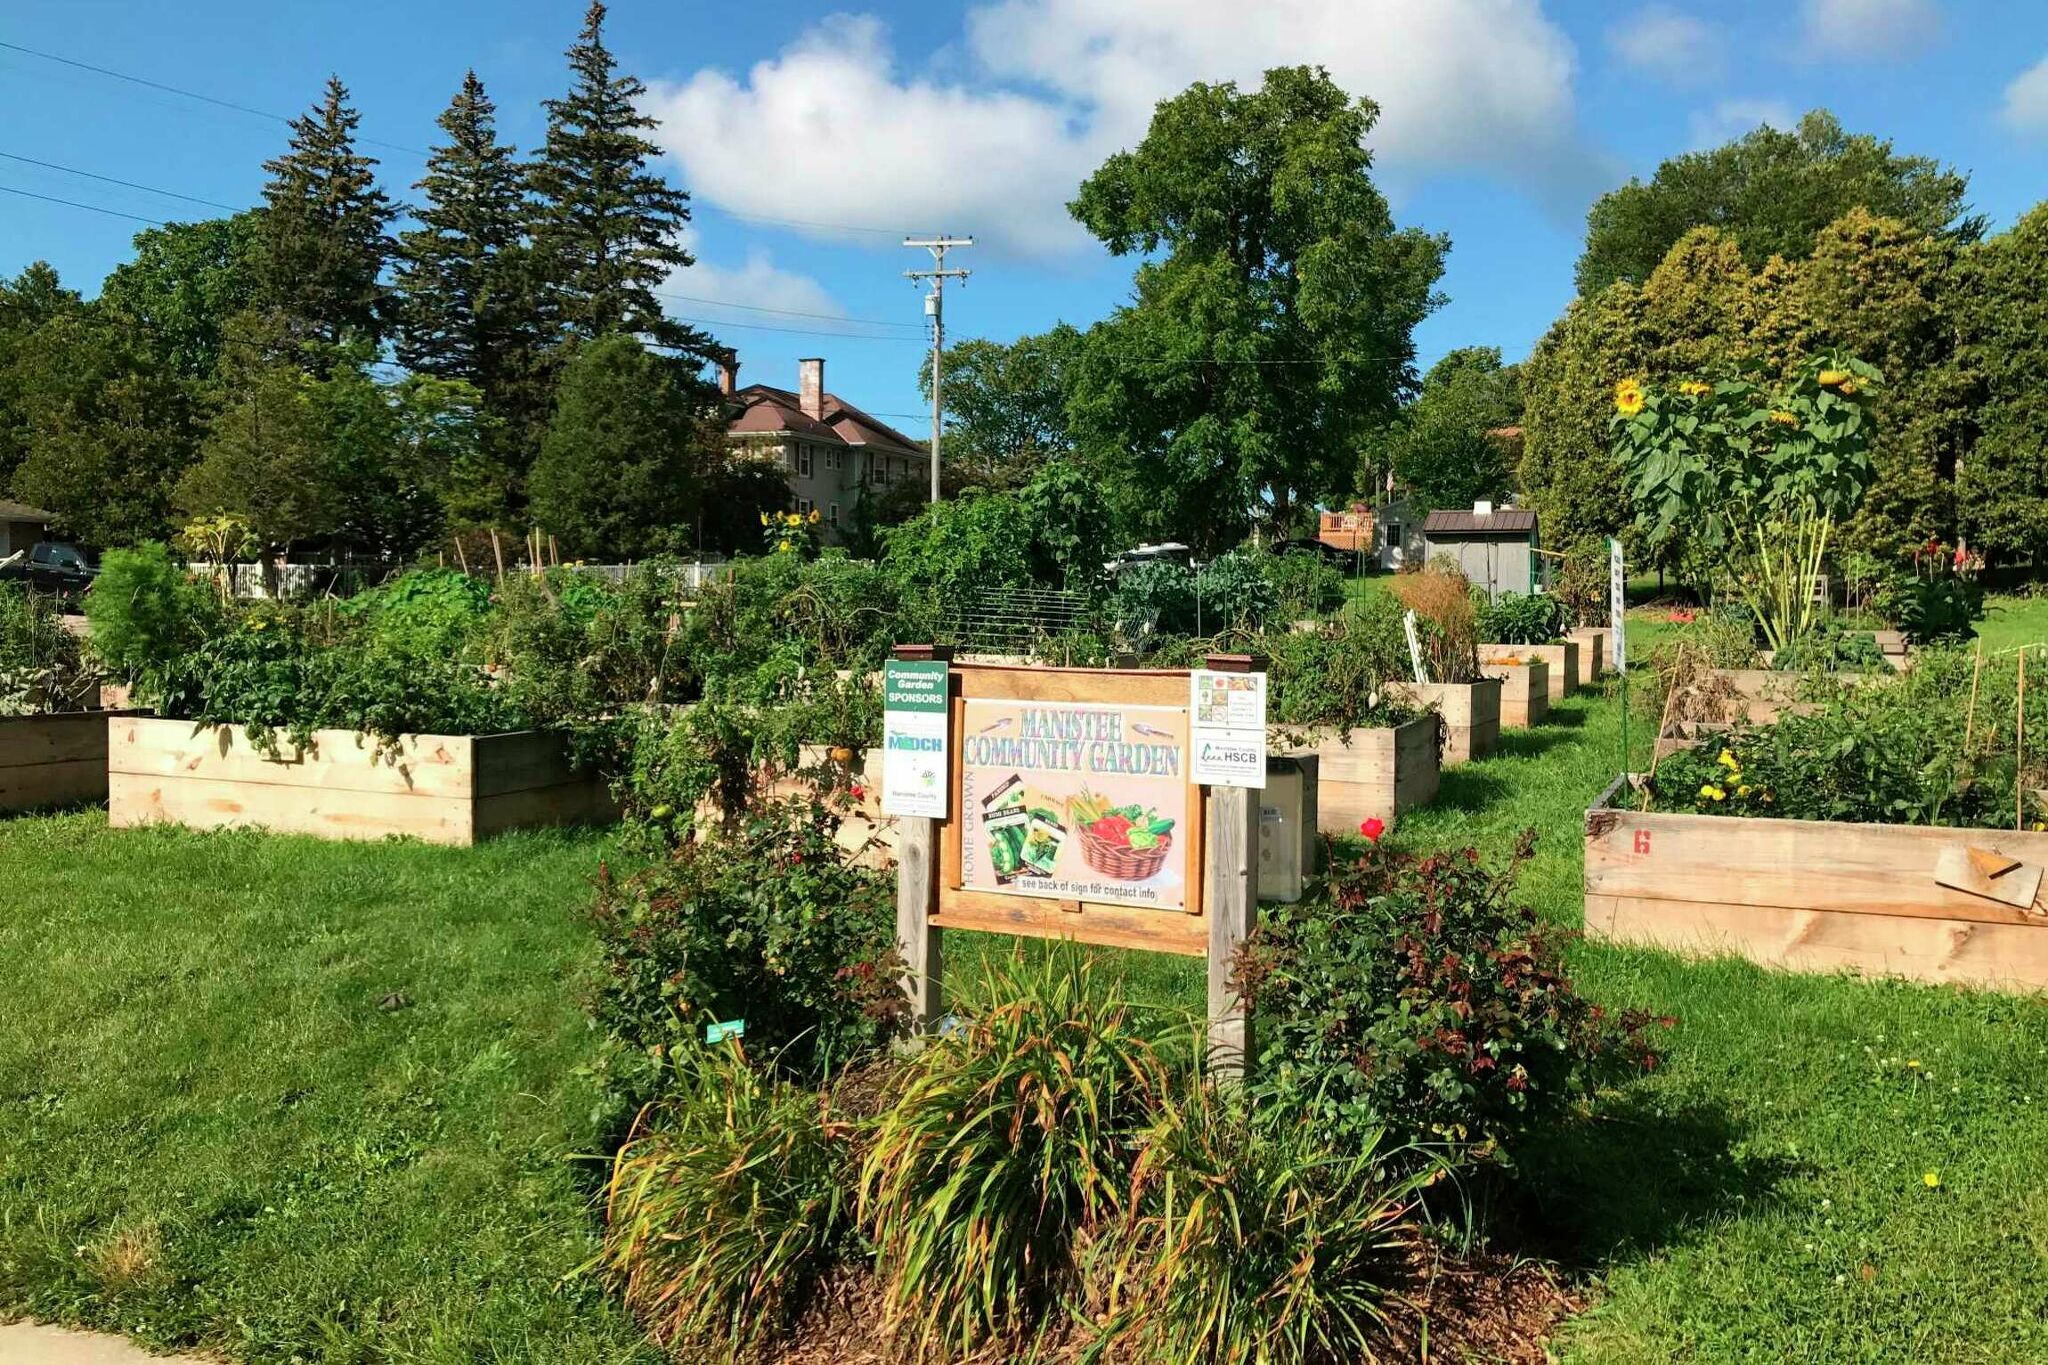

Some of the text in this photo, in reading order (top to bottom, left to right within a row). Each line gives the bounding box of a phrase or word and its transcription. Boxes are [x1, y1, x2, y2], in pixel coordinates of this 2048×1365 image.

[888, 669, 944, 683] Community
[897, 679, 934, 690] Garden
[888, 692, 943, 704] SPONSORS
[1019, 708, 1122, 742] MANISTEE
[965, 735, 1086, 771] COMMUNITY
[1088, 740, 1181, 776] GARDEN
[1224, 752, 1257, 763] HSCB
[964, 771, 974, 883] HOME GROWN
[1634, 830, 1650, 854] 6
[1022, 879, 1037, 888] see
[1038, 879, 1058, 891] back
[1060, 880, 1069, 891] of
[1071, 883, 1089, 895] sign
[1090, 883, 1102, 895] for
[1104, 885, 1136, 898] contact
